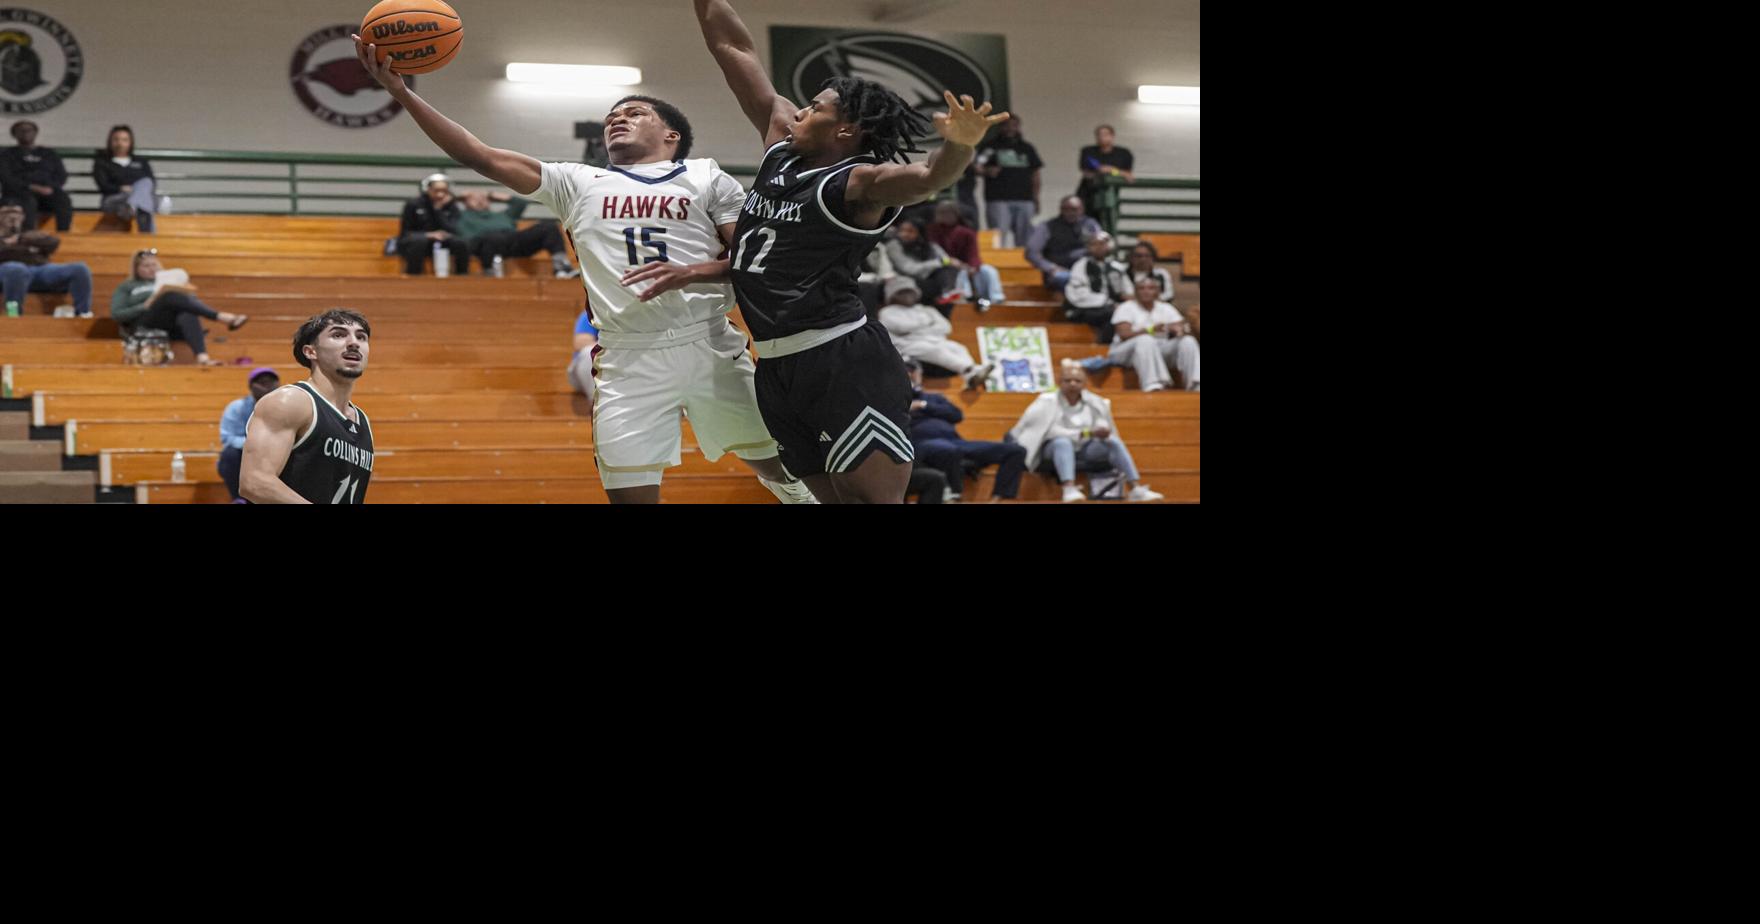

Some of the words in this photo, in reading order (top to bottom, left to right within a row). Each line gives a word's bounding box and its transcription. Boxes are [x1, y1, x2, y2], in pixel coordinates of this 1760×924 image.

[371, 20, 439, 39] Wilson
[602, 195, 691, 220] HAWKS
[622, 227, 669, 265] 15
[732, 226, 777, 274] 12
[323, 437, 359, 466] COLLINS
